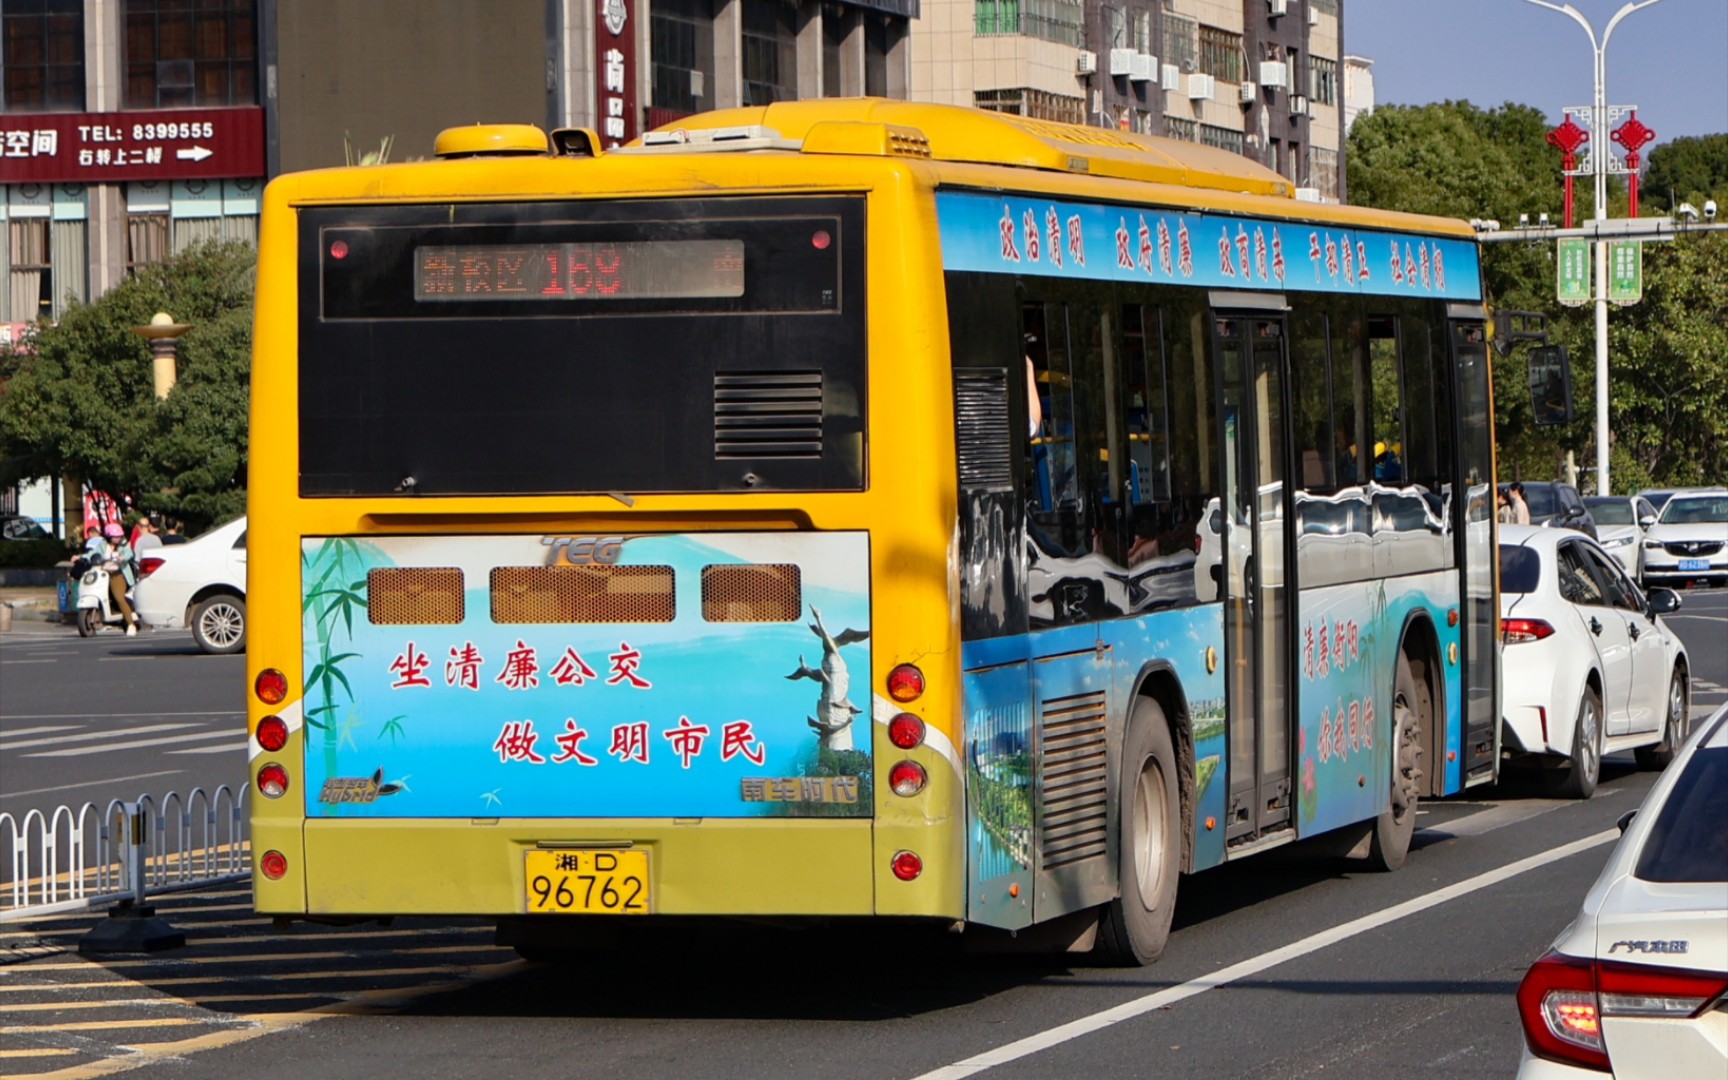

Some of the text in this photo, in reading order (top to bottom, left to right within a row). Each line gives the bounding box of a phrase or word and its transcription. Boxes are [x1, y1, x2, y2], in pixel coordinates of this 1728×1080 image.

[605, 48, 625, 148] 尚品
[78, 122, 214, 142] TEL: 8399555
[78, 147, 163, 166] 右转上二楼
[1000, 204, 1085, 268] 政治清明
[1116, 213, 1193, 277] 政府清廉
[541, 537, 624, 567] TEG
[387, 640, 653, 692] 坐清廉公交
[494, 715, 766, 769] 做文明市民
[1317, 697, 1375, 764] 你我同行
[741, 775, 859, 803] 南车时代
[532, 875, 643, 909] 96762
